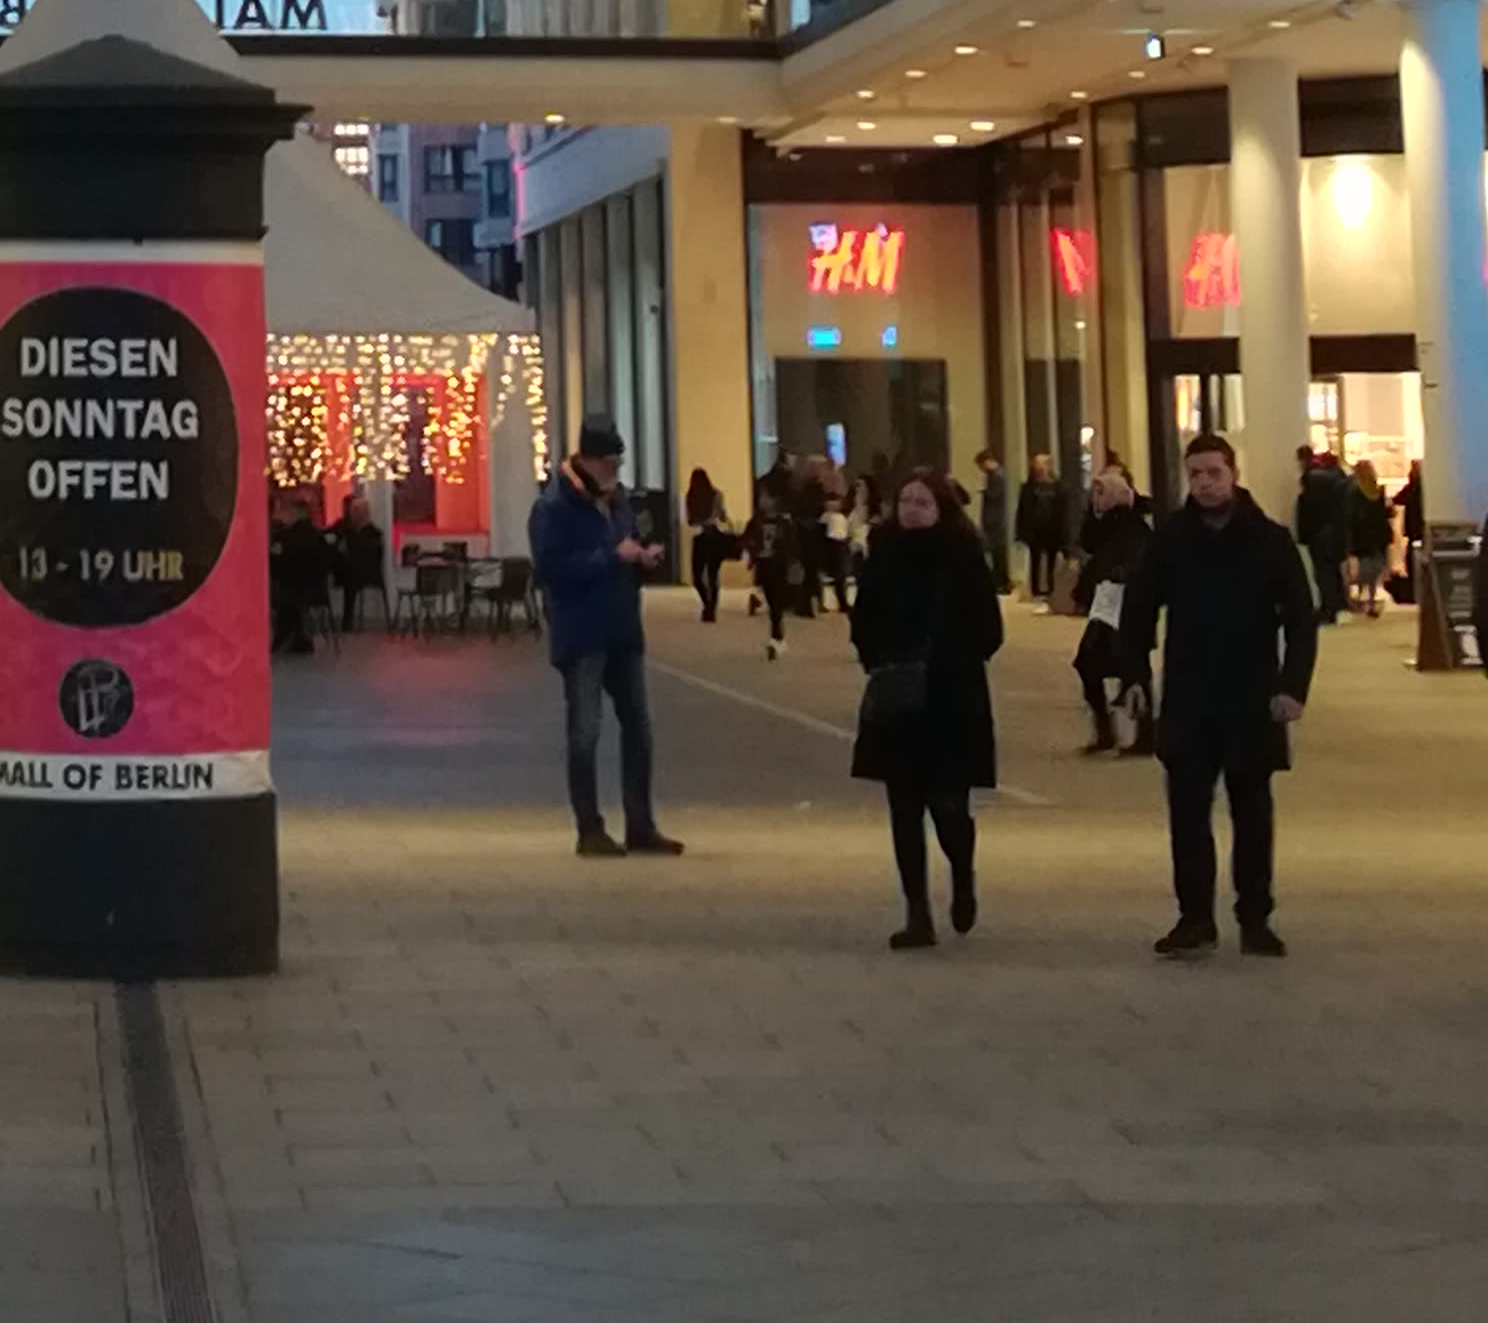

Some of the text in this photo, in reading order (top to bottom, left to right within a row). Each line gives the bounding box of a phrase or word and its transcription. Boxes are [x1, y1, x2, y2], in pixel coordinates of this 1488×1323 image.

[20, 337, 178, 378] DIESEN
[1, 398, 199, 440] SONNTAG
[27, 459, 170, 501] OFFEN
[79, 547, 115, 581] 19
[121, 548, 185, 582] UHR
[63, 763, 102, 790] OF
[114, 760, 213, 791] BERLIN
